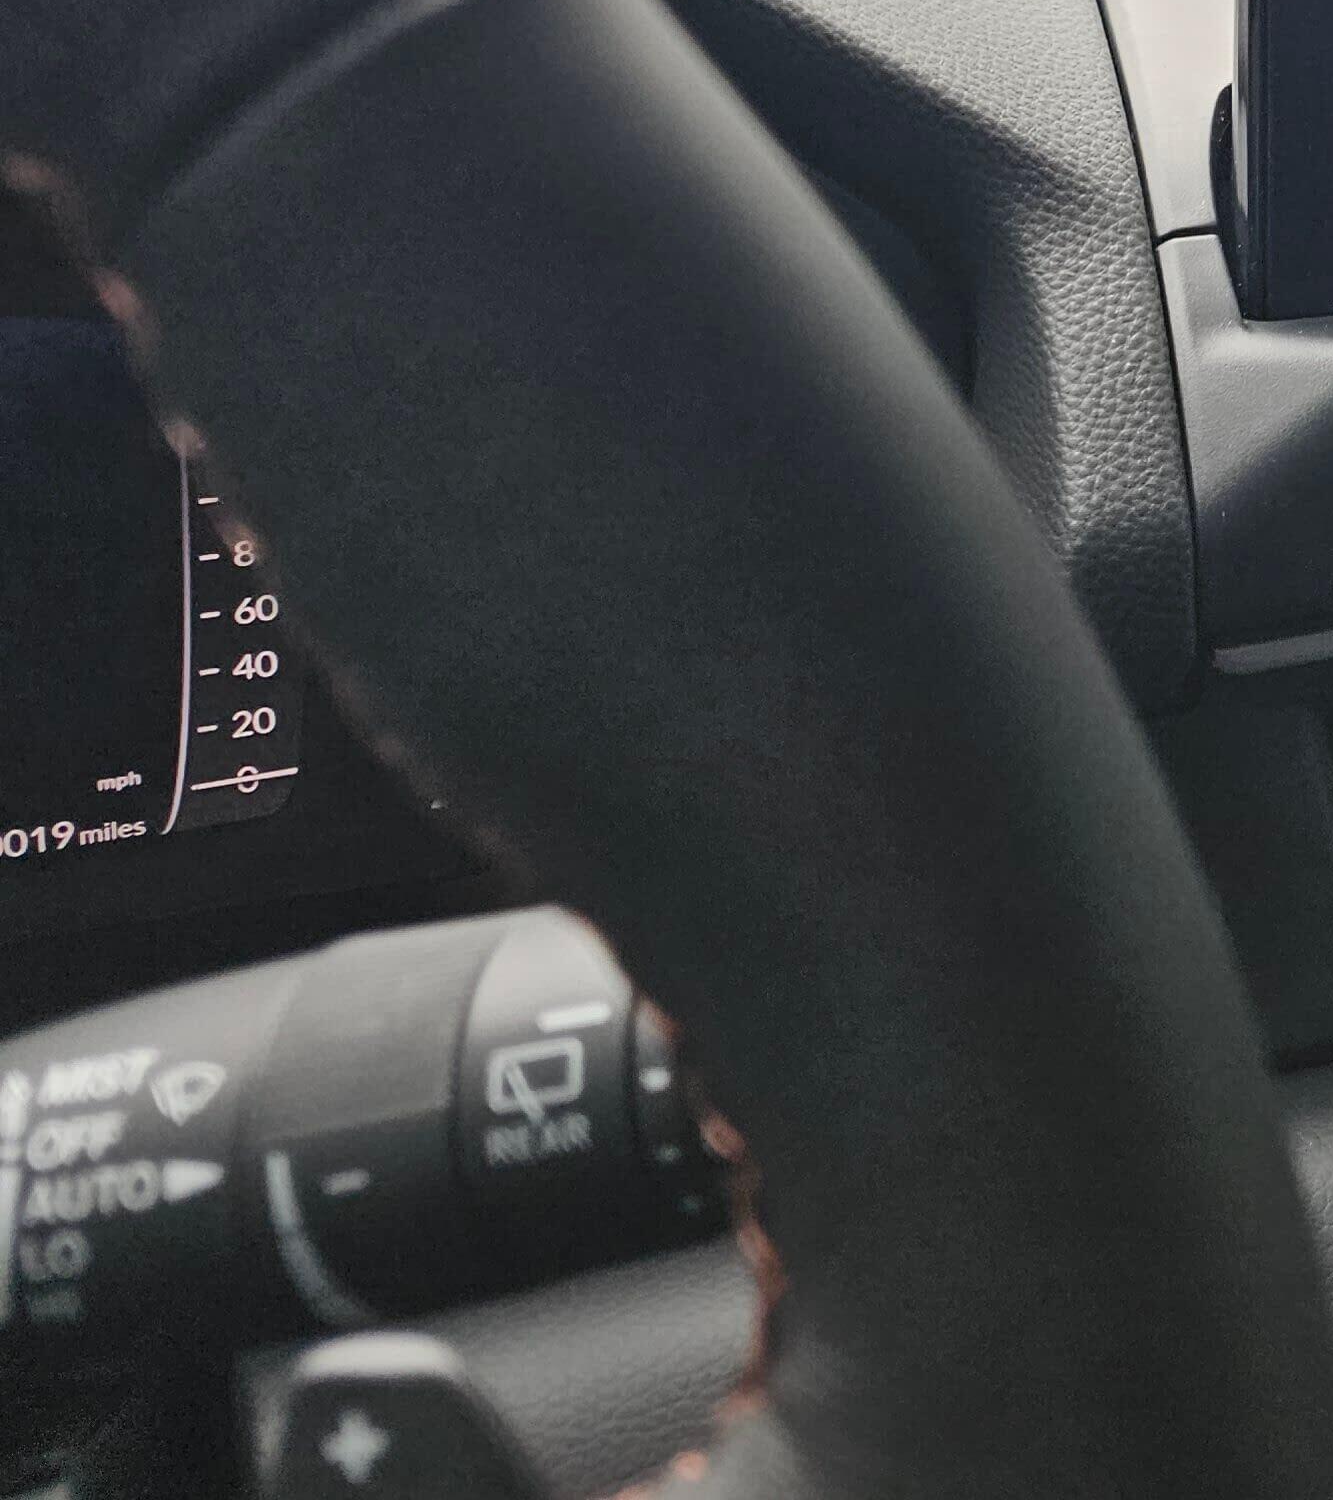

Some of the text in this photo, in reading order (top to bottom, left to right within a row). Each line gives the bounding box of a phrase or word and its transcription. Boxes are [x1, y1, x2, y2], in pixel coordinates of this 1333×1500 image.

[233, 540, 255, 567] 8
[234, 594, 279, 625] 60
[232, 651, 279, 680] 40
[231, 707, 277, 739] 20
[96, 771, 142, 792] mph
[236, 765, 260, 794] 0
[79, 820, 147, 846] miles
[24, 1161, 159, 1226] AUTO
